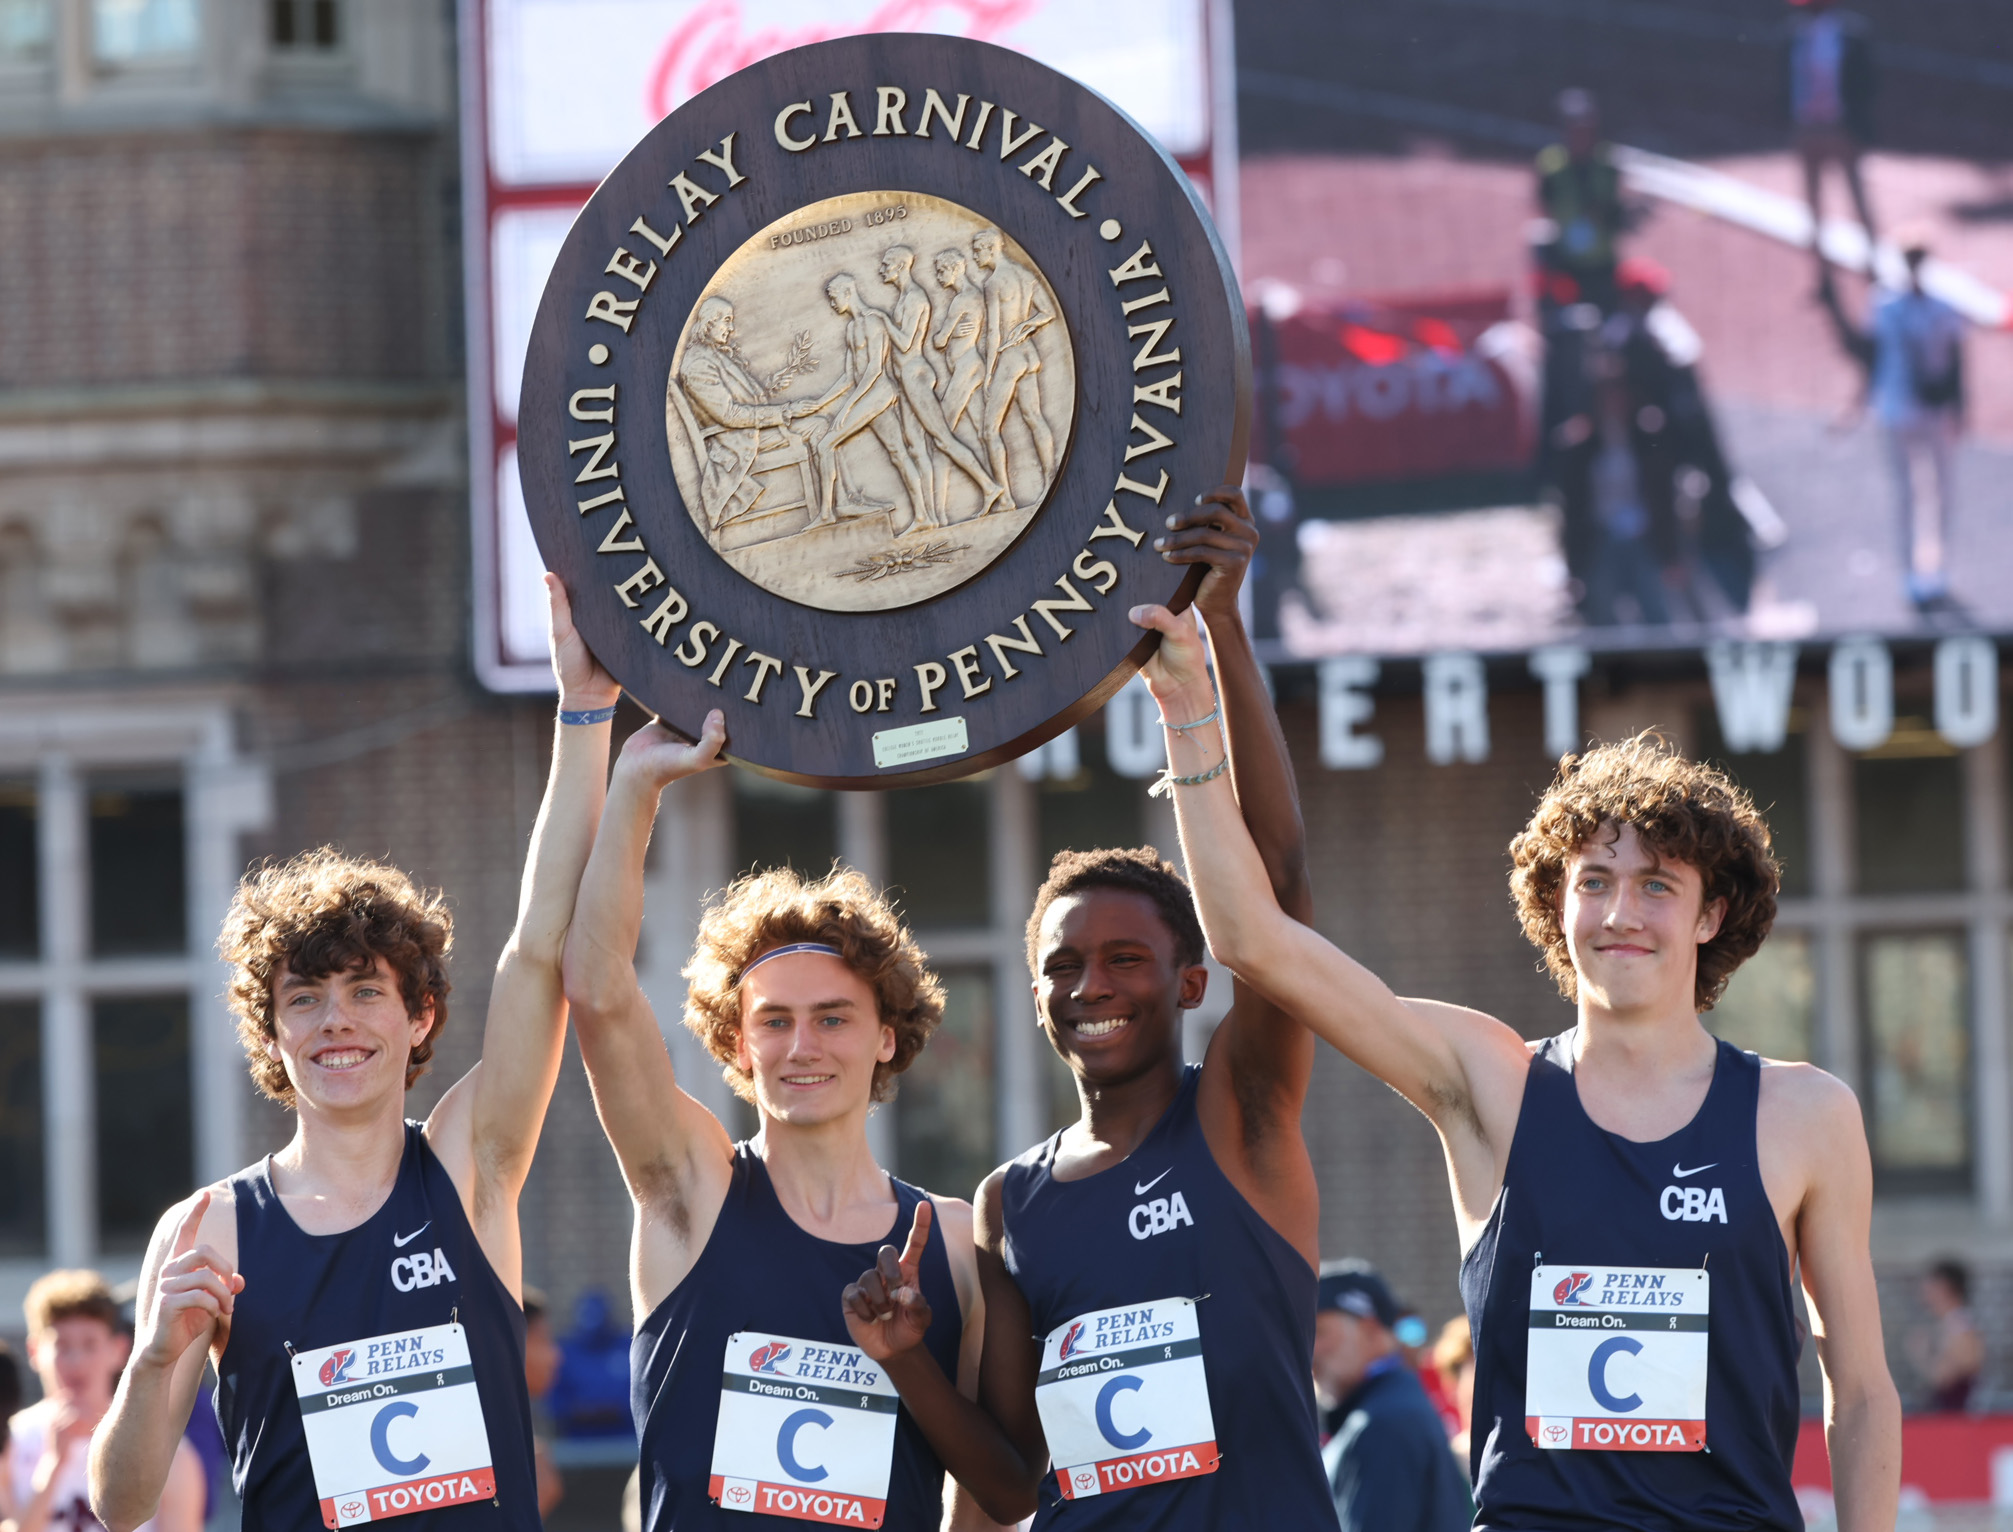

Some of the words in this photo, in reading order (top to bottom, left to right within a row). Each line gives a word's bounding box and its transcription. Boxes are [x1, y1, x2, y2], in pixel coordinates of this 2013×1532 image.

[585, 131, 746, 335] RELAY
[774, 86, 1102, 219] CARNIVAL
[770, 219, 852, 249] FOUNDED
[865, 205, 908, 228] 1895
[568, 384, 838, 719] UNIVERSITY
[849, 678, 897, 714] OF
[913, 239, 1183, 713] PENNSYLVANIA
[1128, 1191, 1194, 1240] CBA
[1660, 1185, 1728, 1224] CBA
[391, 1248, 456, 1292] CBA
[1603, 1273, 1666, 1289] PENN
[1600, 1291, 1684, 1306] RELAYS
[1095, 1321, 1174, 1349] RELAYS
[1096, 1308, 1154, 1332] PENN
[1555, 1314, 1599, 1328] Dream
[1601, 1315, 1626, 1328] On.
[367, 1336, 424, 1359] PENN
[367, 1349, 444, 1376] RELAYS
[801, 1347, 862, 1368] PENN
[795, 1363, 878, 1386] RELAYS
[1058, 1361, 1098, 1379] Dream
[1099, 1357, 1124, 1370] On.
[1588, 1336, 1644, 1413] C
[326, 1388, 371, 1407] Dream
[373, 1383, 398, 1397] On.
[749, 1380, 793, 1397] Dream
[795, 1387, 820, 1401] On.
[1095, 1374, 1153, 1450] C
[370, 1401, 431, 1476] C
[777, 1408, 834, 1482] C
[1578, 1423, 1686, 1445] TOYOTA
[1101, 1450, 1200, 1486] TOYOTA
[373, 1476, 478, 1513] TOYOTA
[762, 1487, 865, 1522] TOYOTA
